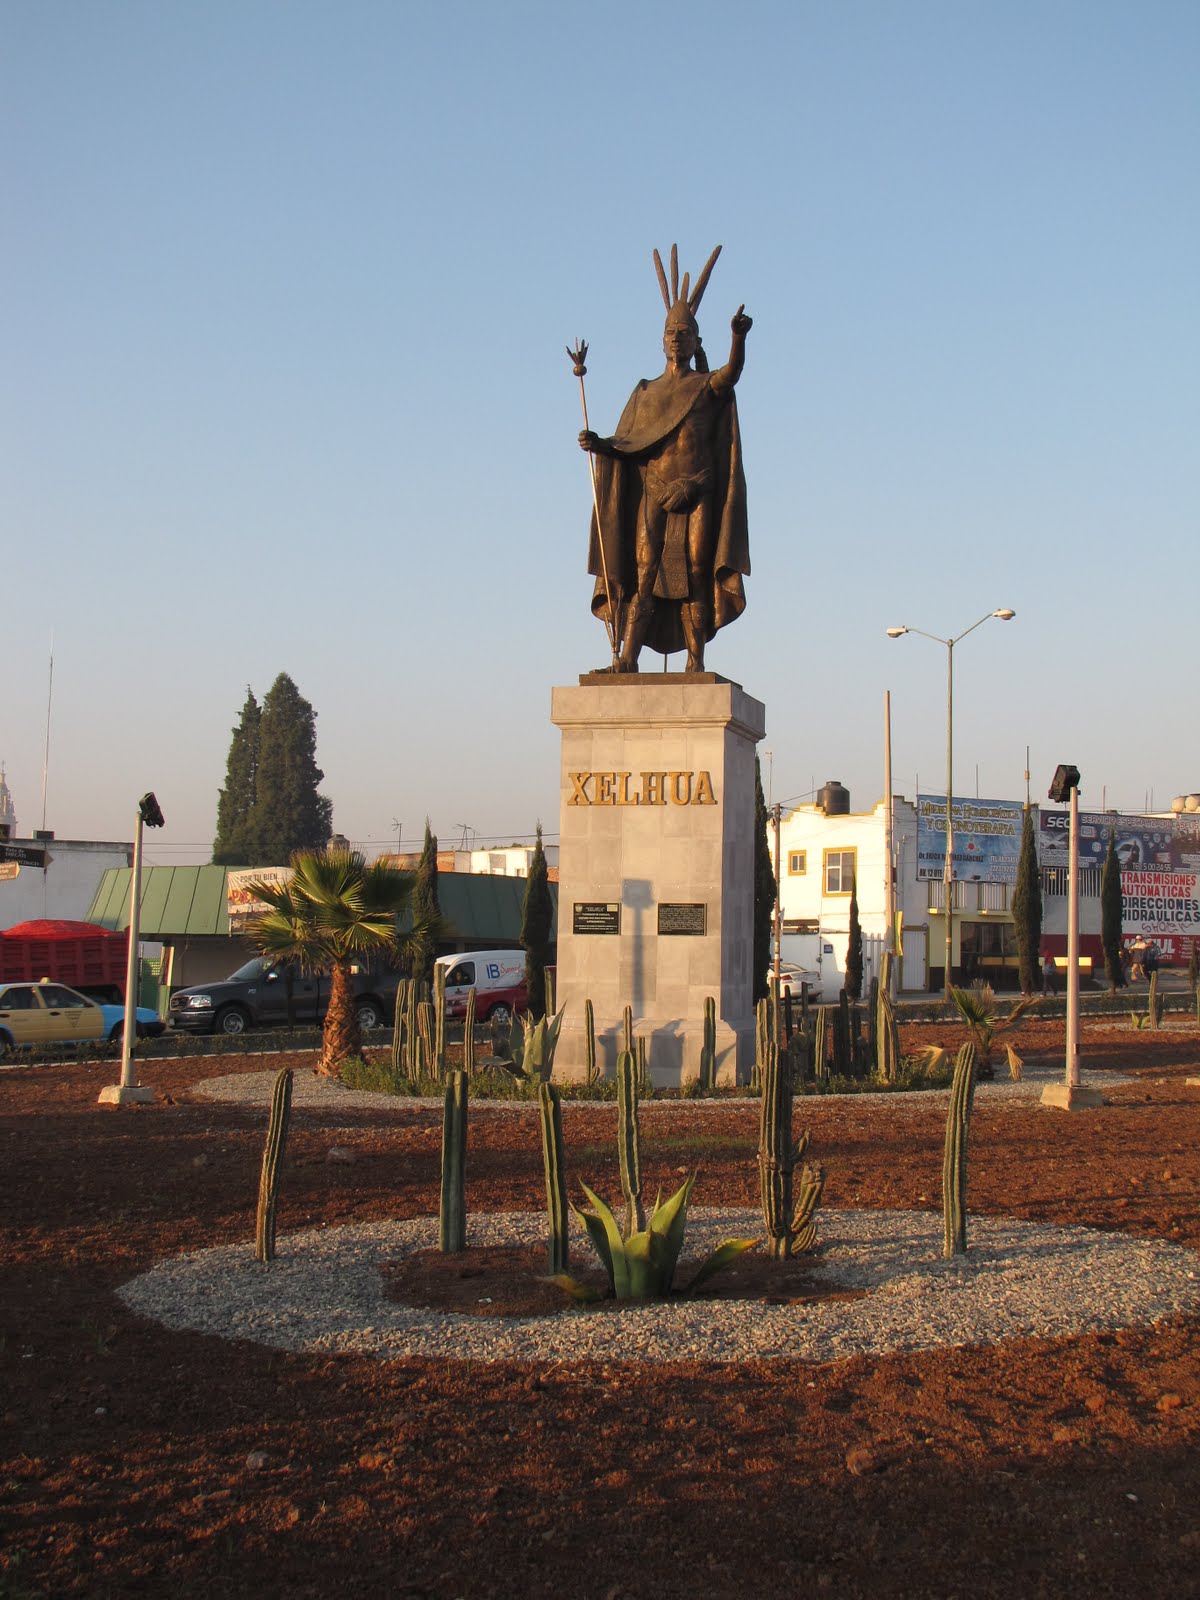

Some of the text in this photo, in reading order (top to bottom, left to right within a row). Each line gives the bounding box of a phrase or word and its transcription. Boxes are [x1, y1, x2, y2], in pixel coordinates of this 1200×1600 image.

[567, 771, 718, 806] XELHUA
[926, 818, 933, 832] Y
[1081, 814, 1115, 826] SERVICIO
[1121, 871, 1197, 886] TRANSMISIONES
[1121, 884, 1191, 898] AUTOMATICAS
[1121, 896, 1198, 910] DIRECCIONES
[1121, 909, 1200, 922] HIDRAULICAS
[486, 963, 500, 979] IB
